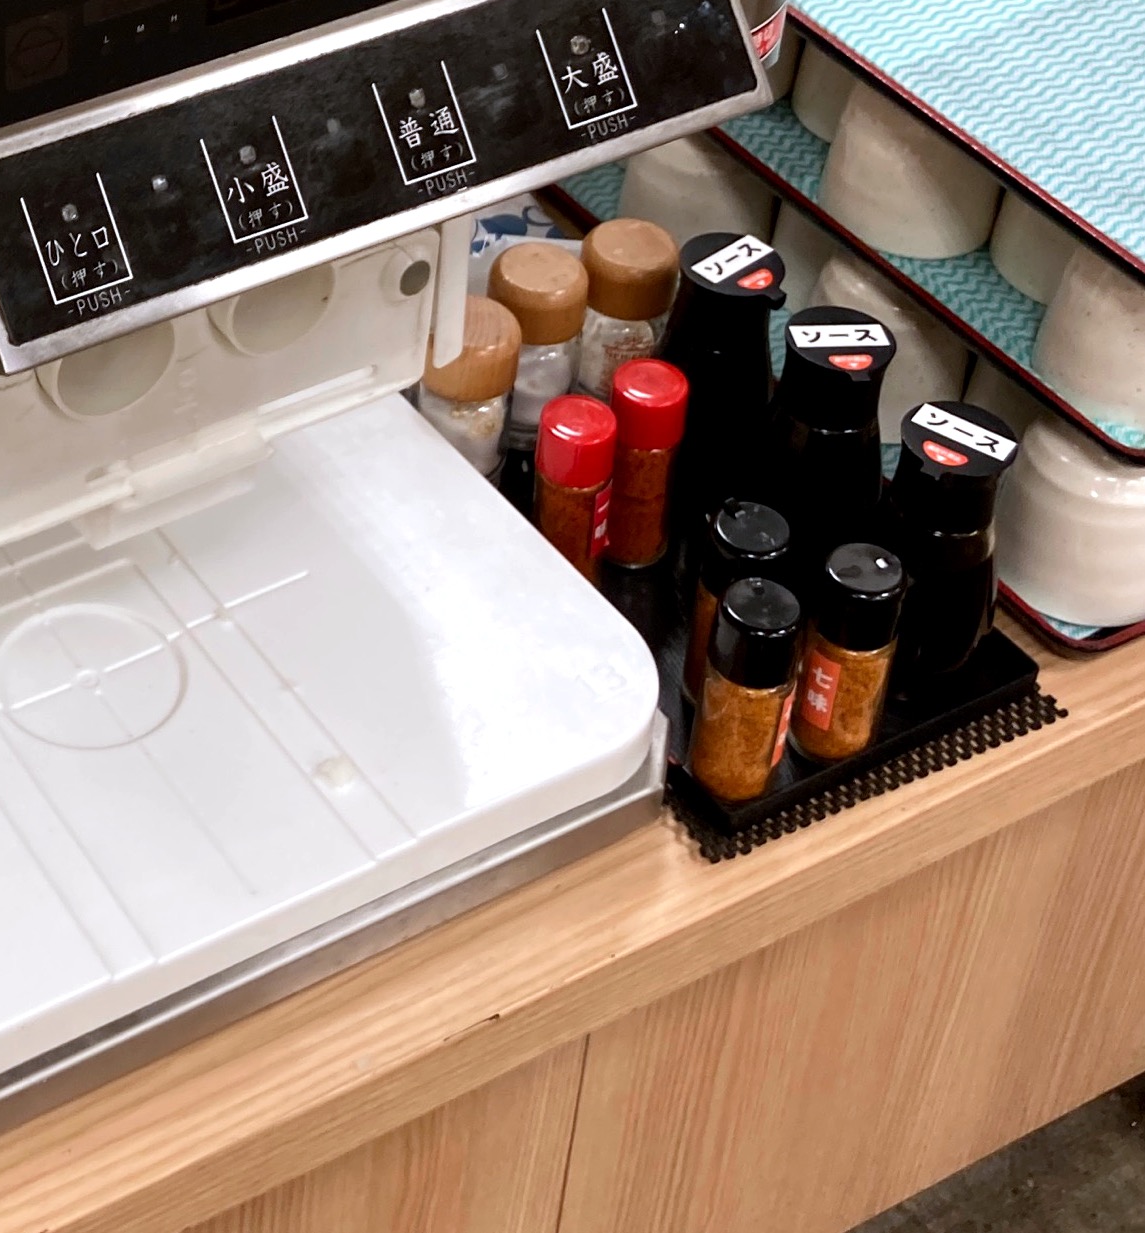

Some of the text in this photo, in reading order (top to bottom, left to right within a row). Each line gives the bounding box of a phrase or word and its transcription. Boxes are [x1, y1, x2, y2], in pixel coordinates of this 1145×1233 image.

[561, 52, 619, 94] 大盛
[399, 106, 460, 149] 普通
[227, 161, 290, 204] 小盛
[45, 226, 110, 267] ひと口
[704, 243, 762, 275] ソース
[801, 328, 878, 343] ソース
[926, 412, 1005, 453] ソース
[807, 667, 833, 713] 七味
